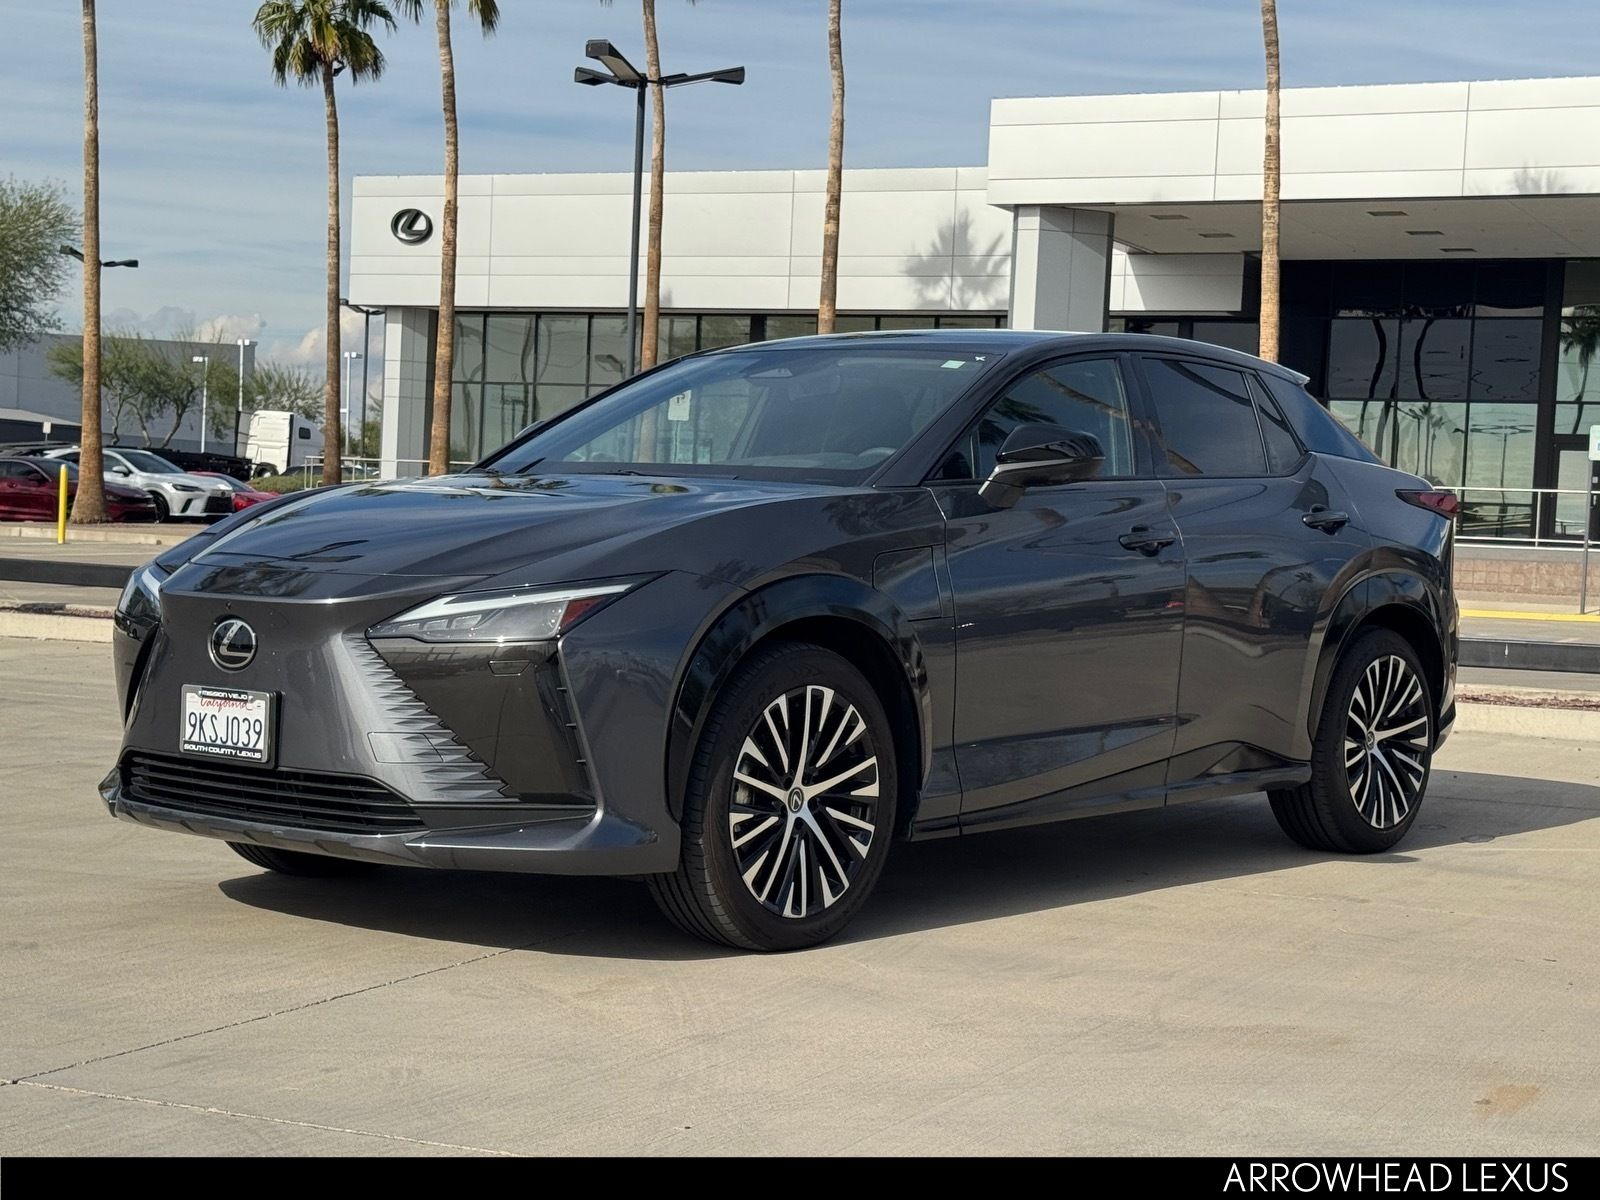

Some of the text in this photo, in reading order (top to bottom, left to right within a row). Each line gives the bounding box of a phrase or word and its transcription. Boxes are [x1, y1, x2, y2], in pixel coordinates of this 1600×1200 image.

[188, 711, 263, 748] 9KSJ039
[183, 743, 262, 759] SOUTH COUNTY LEXUS
